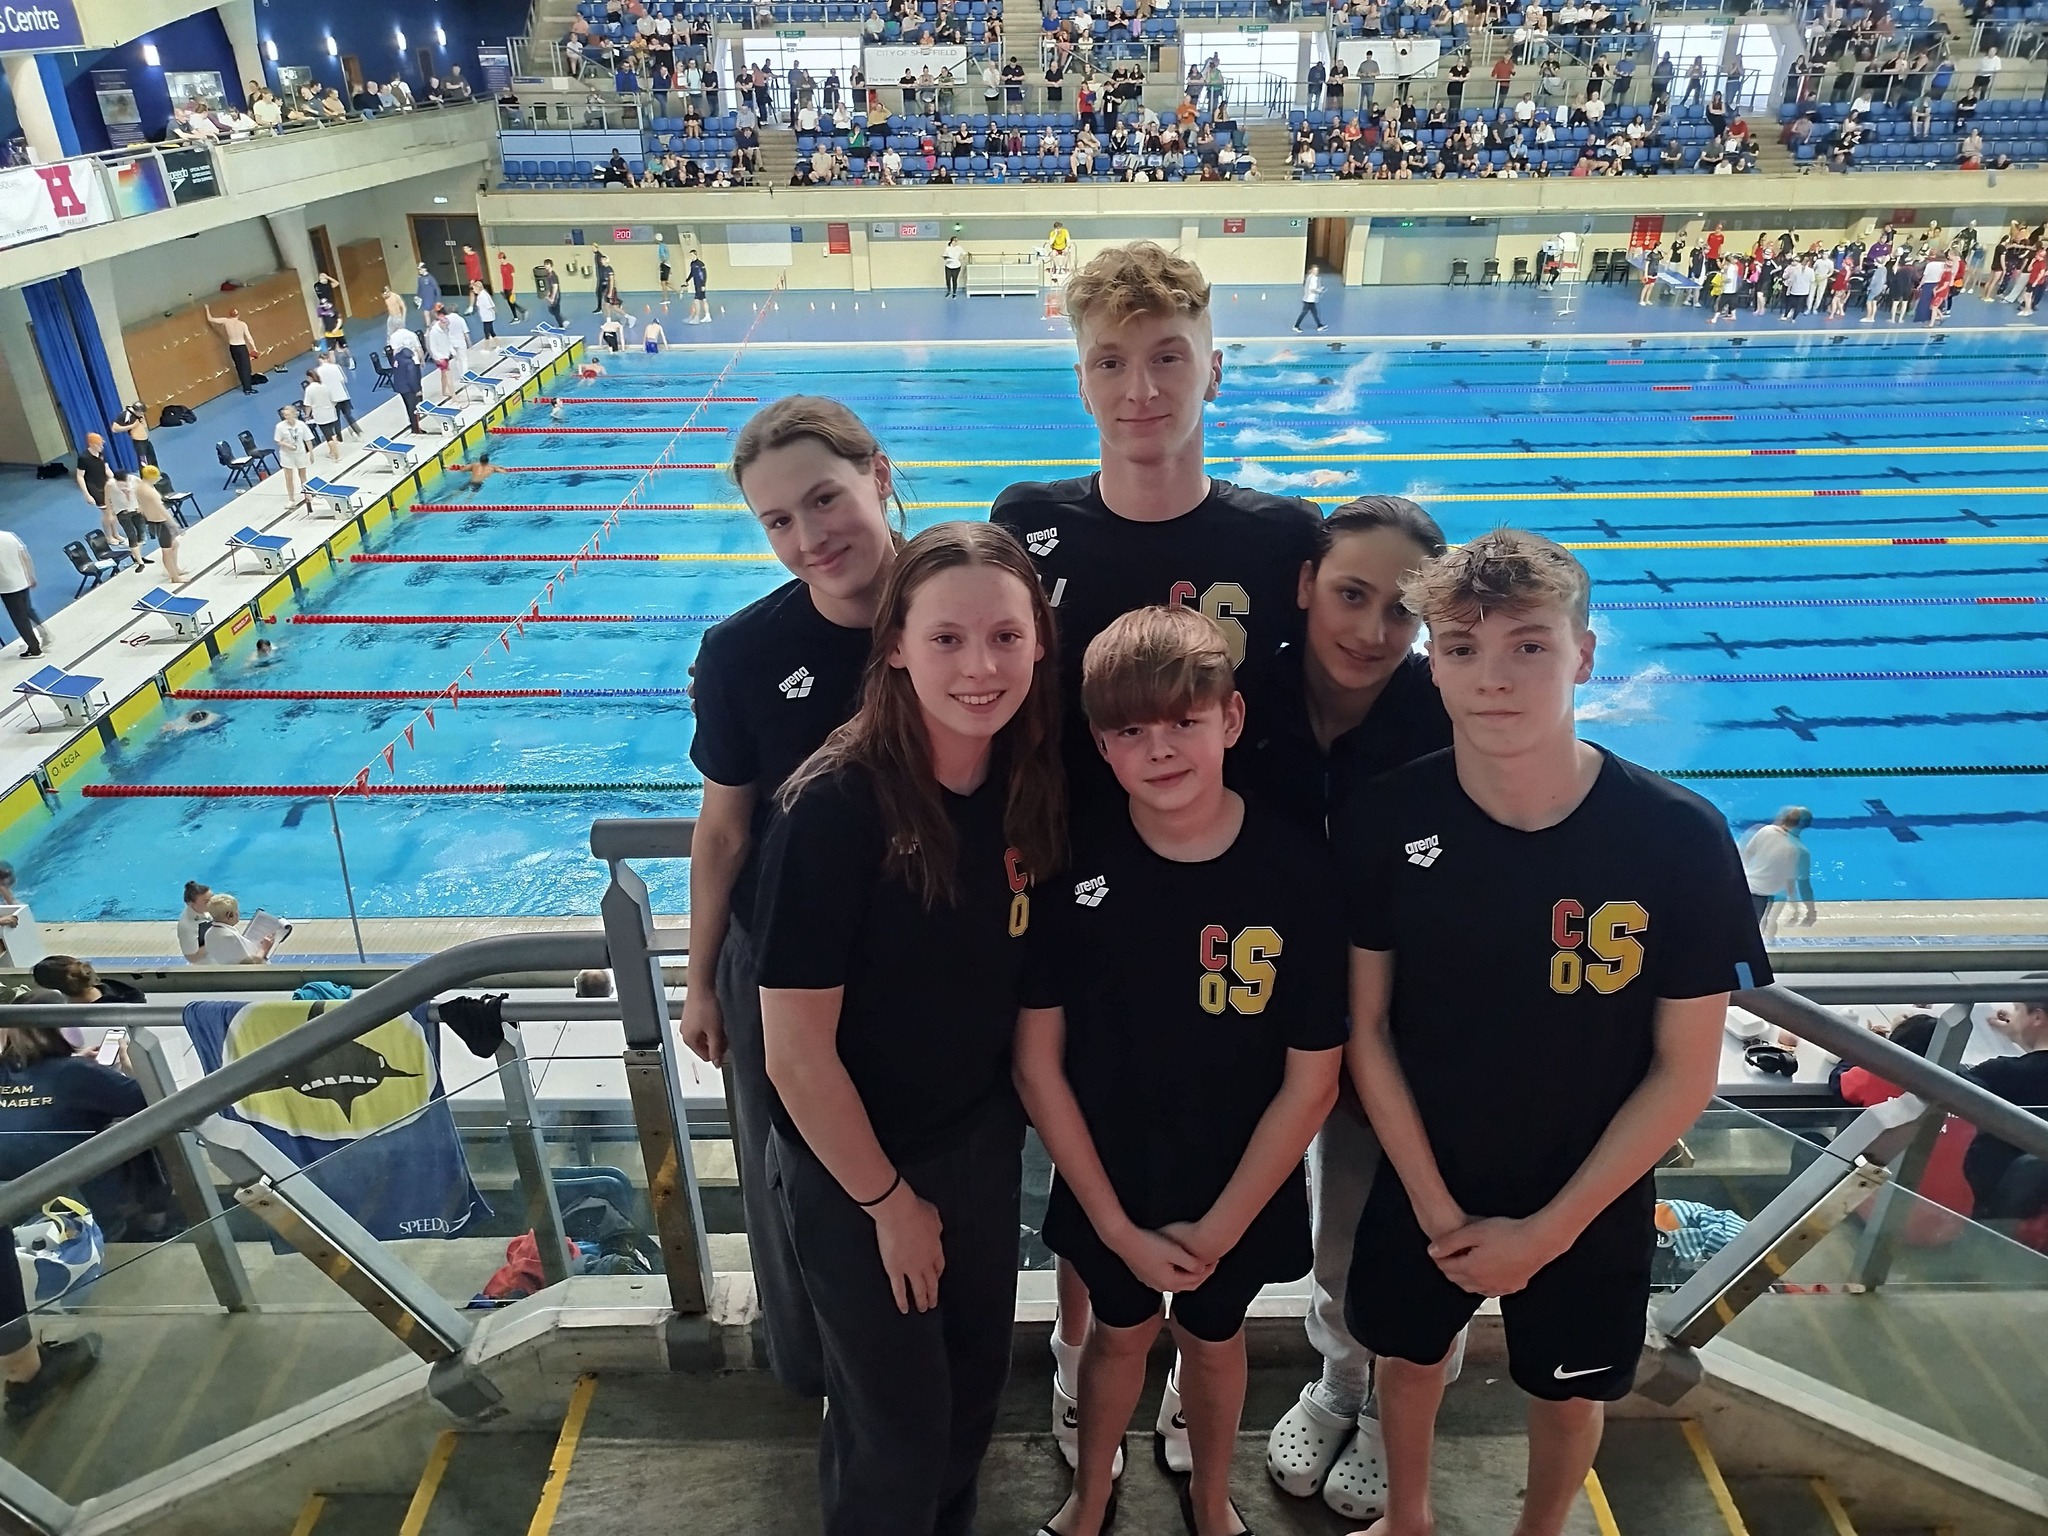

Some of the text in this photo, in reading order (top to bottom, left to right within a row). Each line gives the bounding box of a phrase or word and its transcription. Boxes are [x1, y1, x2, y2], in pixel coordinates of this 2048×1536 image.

[4, 5, 60, 33] Centre
[17, 224, 49, 237] Swimming
[615, 230, 631, 239] 200
[901, 226, 917, 236] 200
[521, 363, 527, 372] 8
[484, 388, 489, 398] 7
[442, 421, 449, 432] 6
[392, 458, 400, 470] 5
[335, 502, 342, 514] 4
[1026, 527, 1058, 544] arena
[263, 557, 272, 570] 3
[174, 622, 186, 635] 2
[778, 665, 810, 693] arena
[64, 703, 73, 717] 1
[1404, 834, 1440, 855] arena
[1074, 874, 1106, 896] arena
[398, 1217, 450, 1235] SPEEDO
